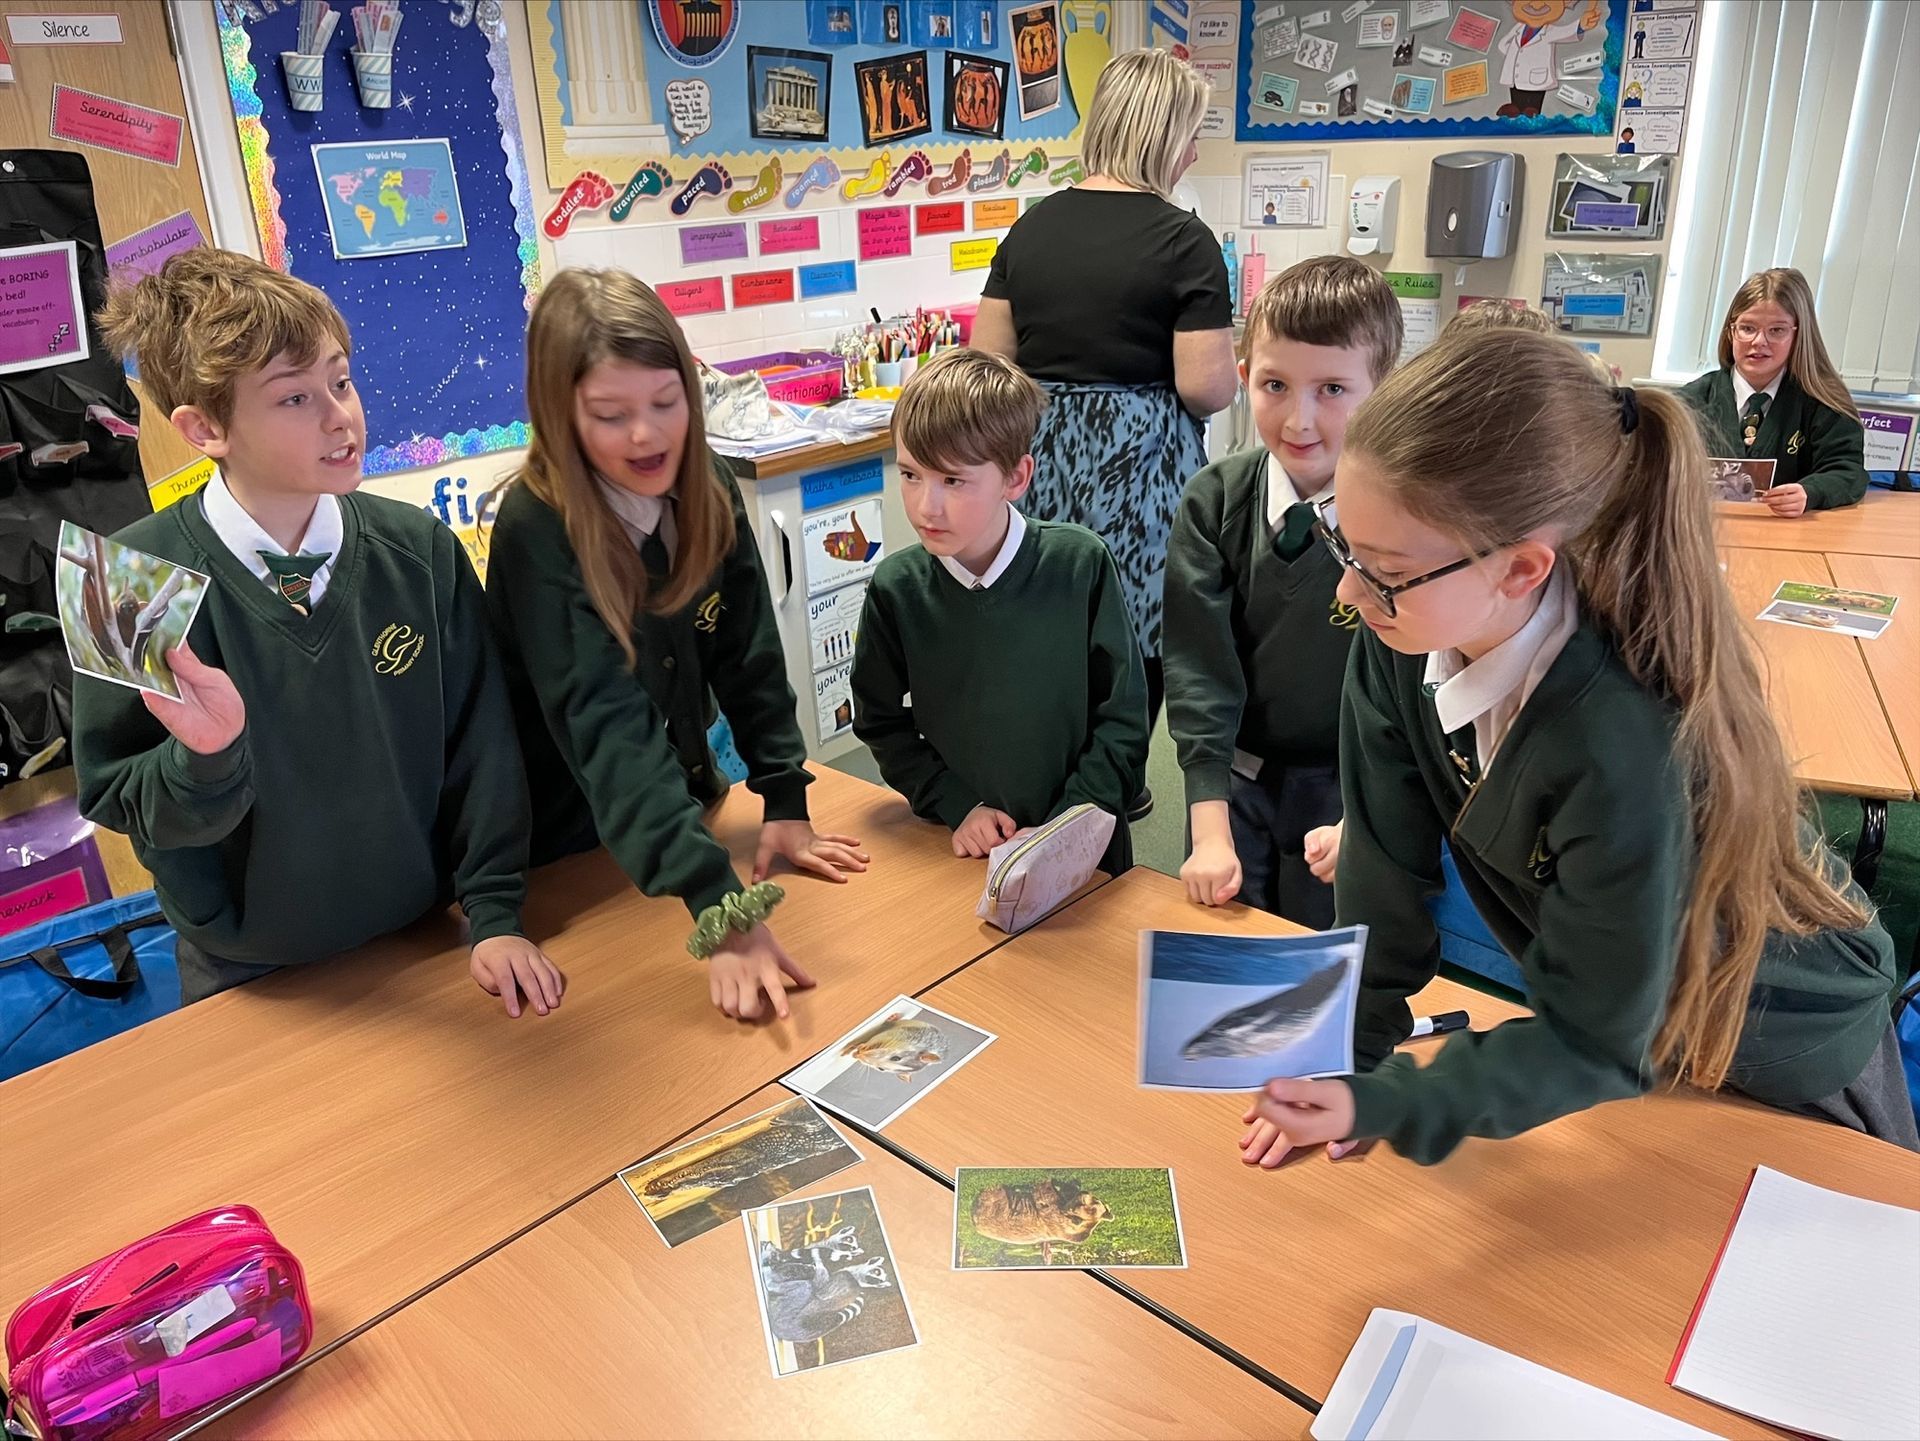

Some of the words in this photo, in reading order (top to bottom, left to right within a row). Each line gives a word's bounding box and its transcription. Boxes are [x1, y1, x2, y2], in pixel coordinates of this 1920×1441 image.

[42, 21, 90, 38] Silence
[1209, 20, 1220, 28] like
[1206, 62, 1232, 71] puzzled
[366, 152, 389, 161] World
[391, 151, 407, 161] Map
[791, 168, 819, 199] roamed
[888, 161, 916, 190] rambled
[942, 174, 957, 188] trod
[973, 172, 1000, 190] plodded
[613, 173, 650, 214] travelled
[681, 176, 706, 206] paced
[742, 186, 769, 207] strode
[551, 186, 584, 227] toddled
[9, 270, 49, 284] BORING
[1405, 277, 1434, 288] Rules
[5, 290, 26, 301] bed!
[773, 382, 833, 402] Stationery
[803, 481, 834, 495] Maths
[804, 518, 830, 536] you're,
[832, 512, 849, 527] your
[811, 595, 838, 620] your
[372, 623, 397, 656] GLENTHORNE
[394, 657, 414, 676] PRIMARY
[413, 634, 424, 658] SCHOOL
[818, 665, 850, 696] you're
